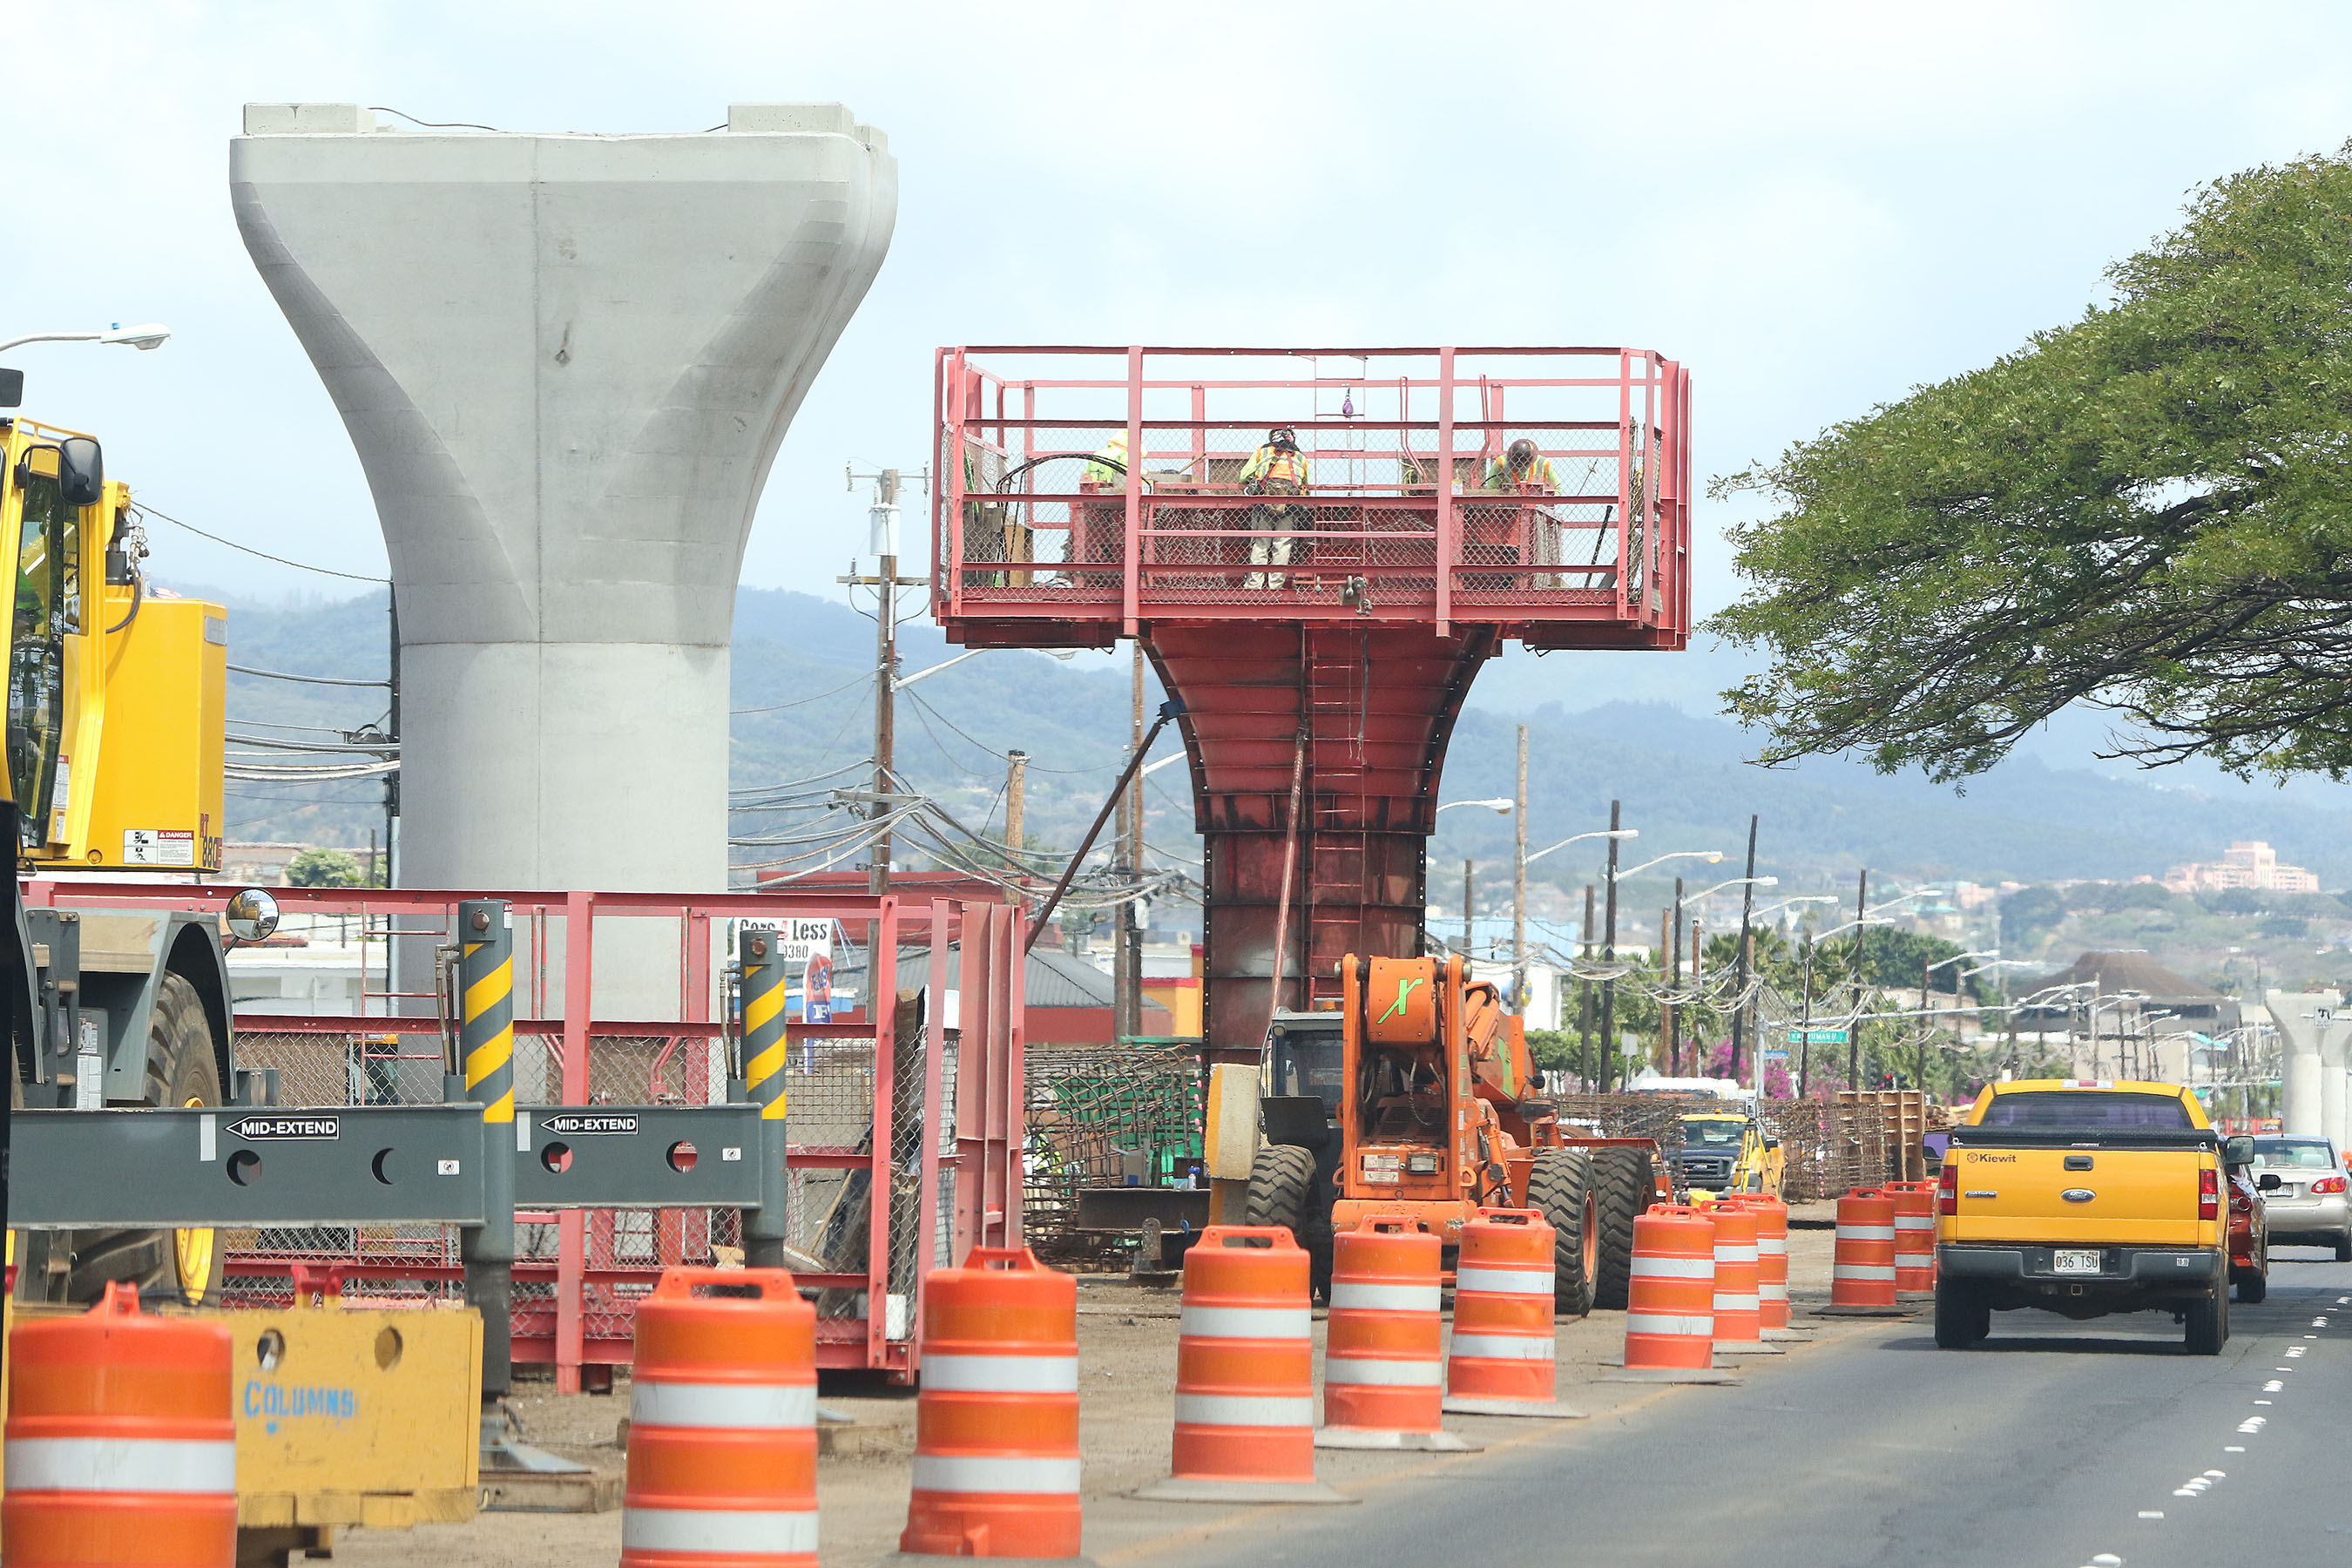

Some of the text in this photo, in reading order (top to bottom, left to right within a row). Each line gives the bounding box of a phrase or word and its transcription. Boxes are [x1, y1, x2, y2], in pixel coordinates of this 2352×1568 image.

[200, 813, 209, 838] RT
[793, 920, 827, 940] Less
[241, 1121, 337, 1134] MID-EXTEND
[554, 1119, 637, 1131] MID-EXTEND
[1979, 1153, 2017, 1163] Kiewit
[2056, 1255, 2099, 1268] 036 TSU
[244, 1380, 354, 1418] COLUMNS
